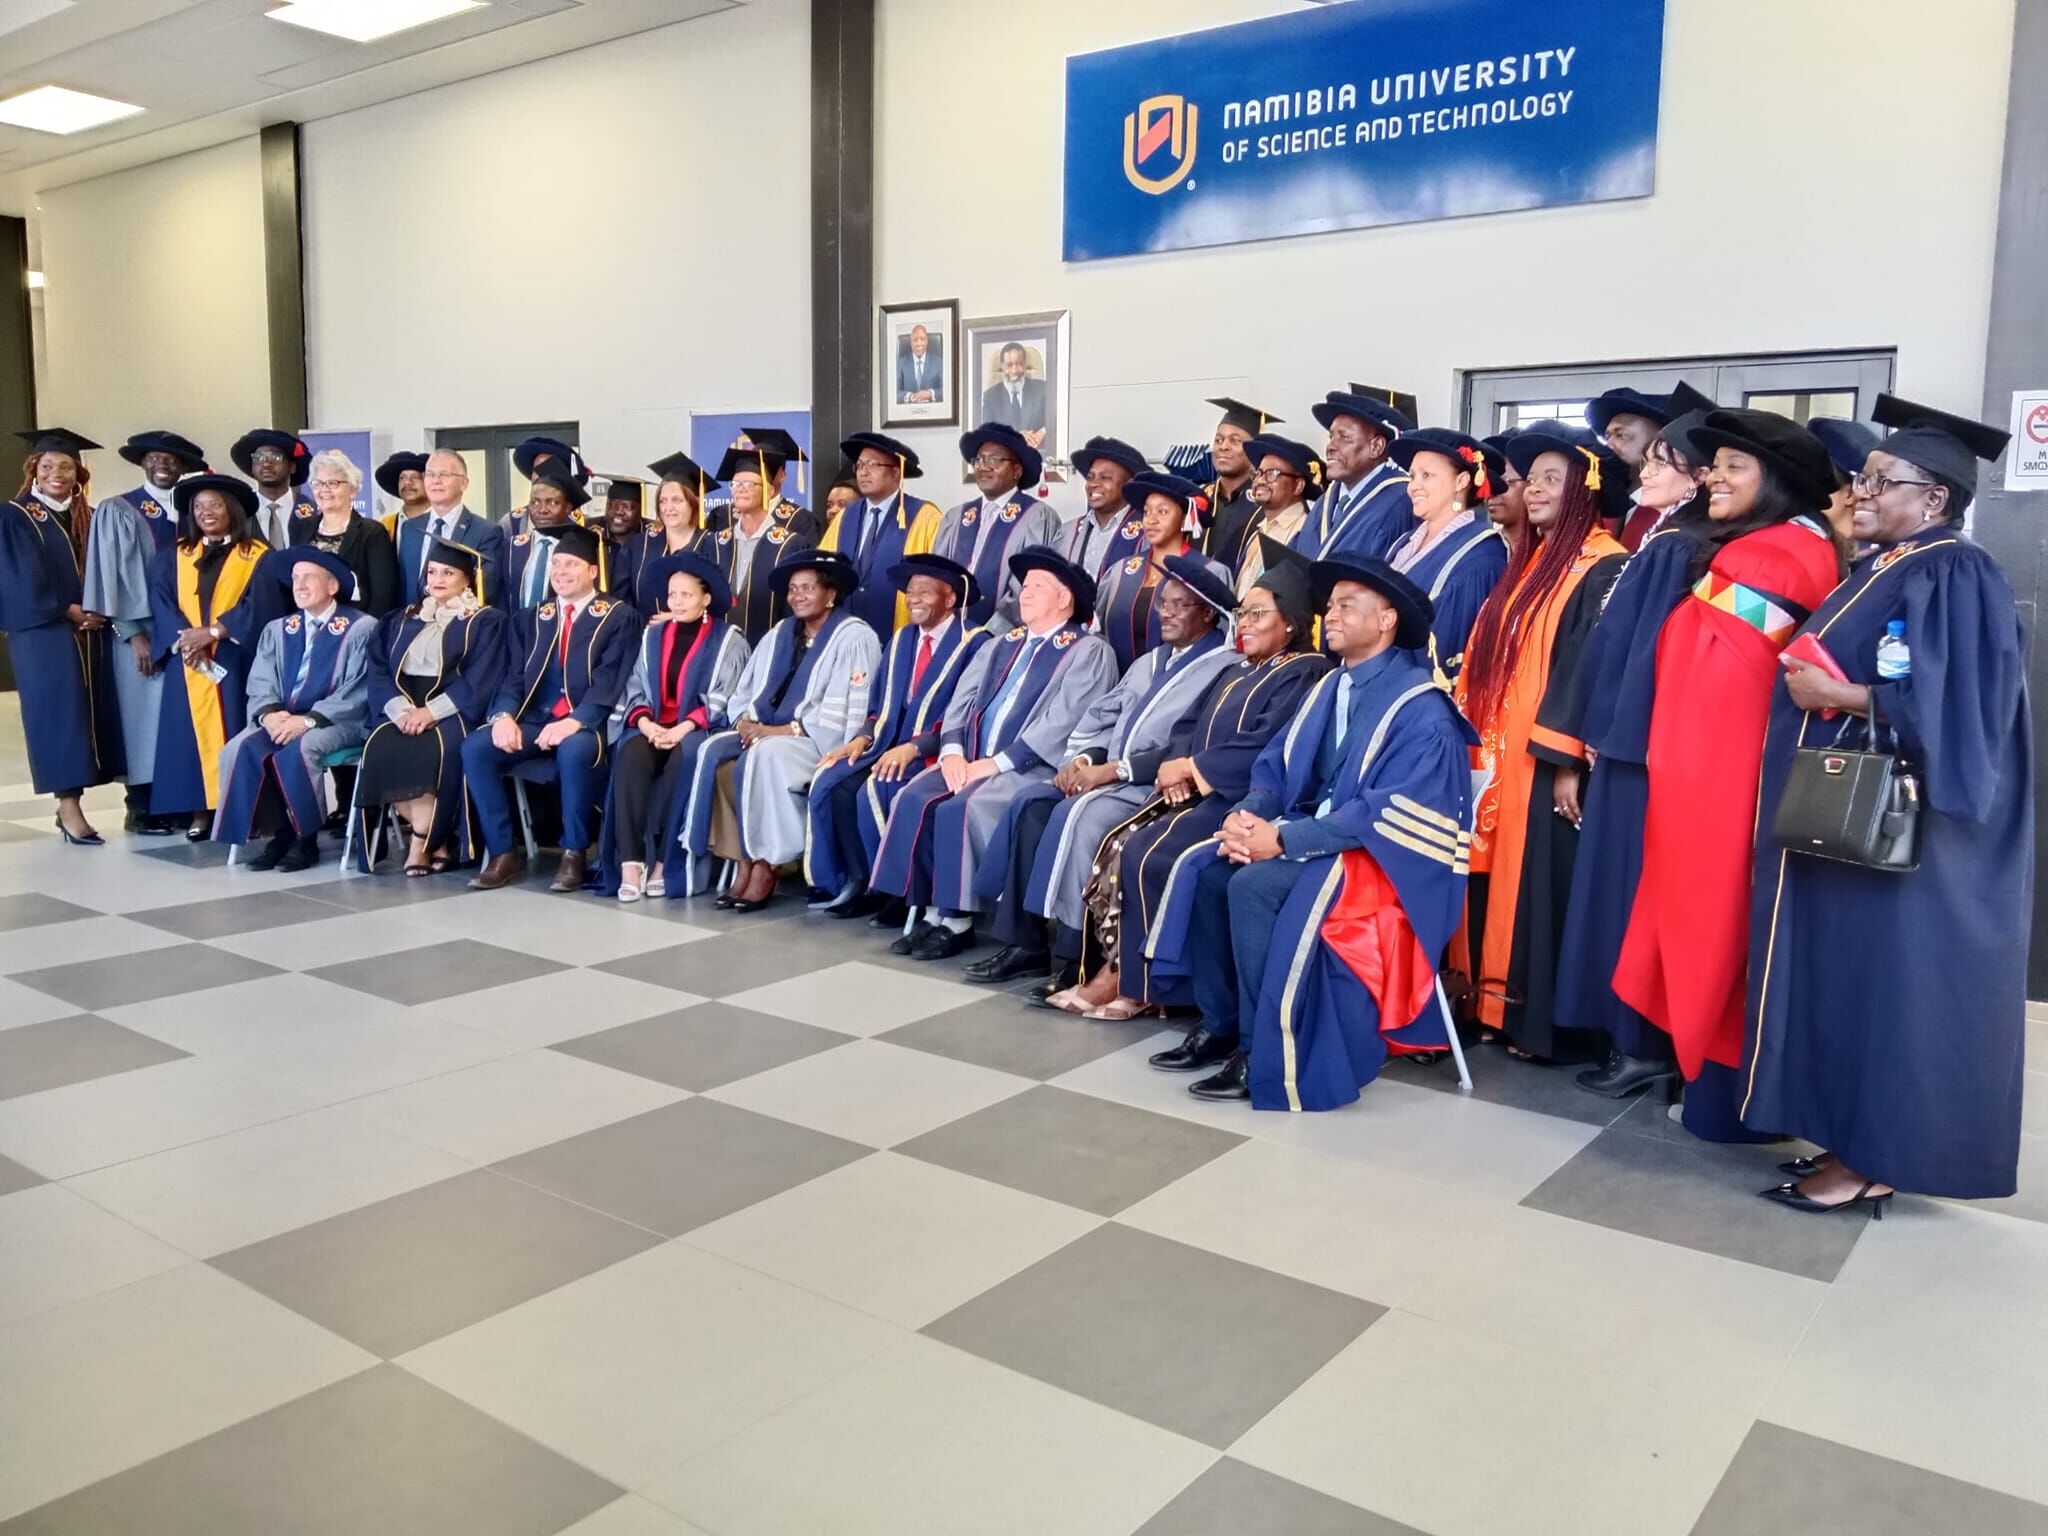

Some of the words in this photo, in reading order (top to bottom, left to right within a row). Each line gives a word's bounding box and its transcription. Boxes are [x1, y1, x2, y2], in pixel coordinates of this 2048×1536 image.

[1222, 139, 1249, 163] OF
[1257, 124, 1347, 158] SCIENCE
[1355, 116, 1402, 144] AND
[1407, 90, 1574, 136] TECHNOLOGY
[1223, 83, 1356, 129] NAMIBIA
[1370, 46, 1576, 105] UNIVERSITY
